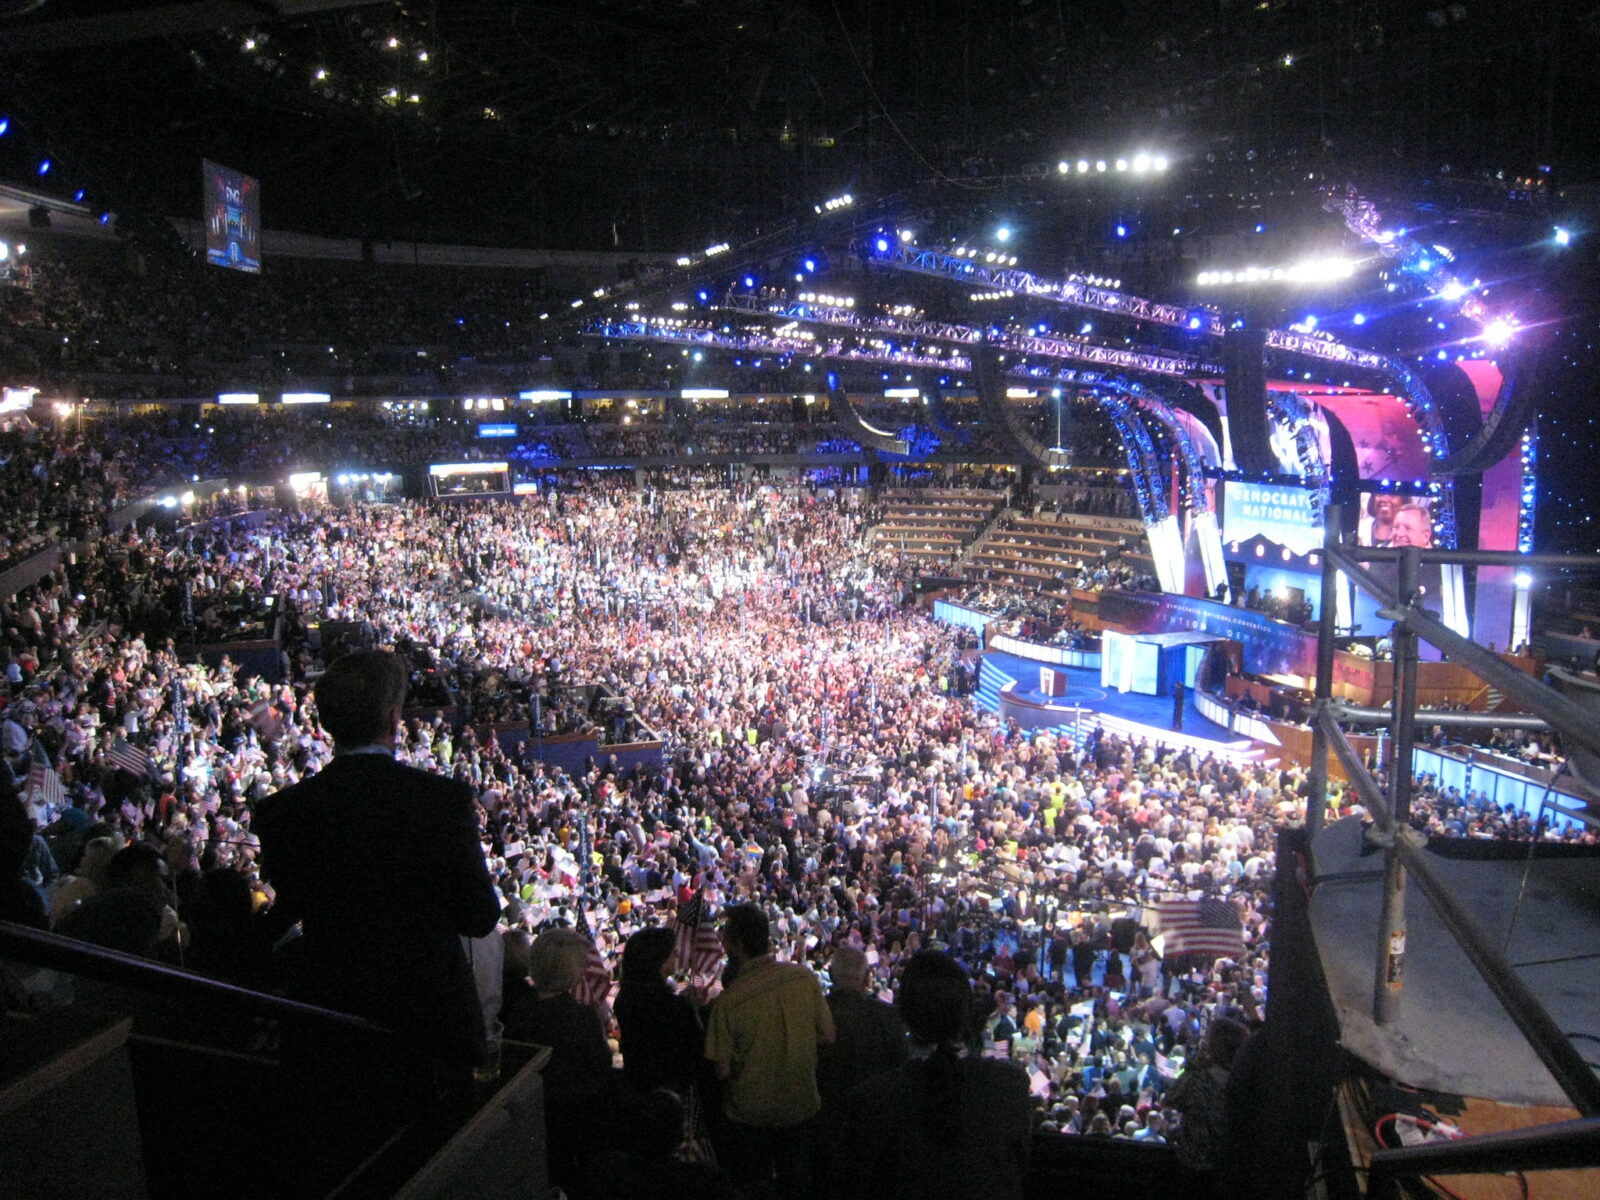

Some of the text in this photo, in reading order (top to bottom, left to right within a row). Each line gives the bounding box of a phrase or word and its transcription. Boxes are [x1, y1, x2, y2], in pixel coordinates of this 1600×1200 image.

[1233, 489, 1312, 508] DEMOCRAT
[1242, 504, 1308, 523] NATIONAL
[1233, 617, 1272, 633] CONVENTION
